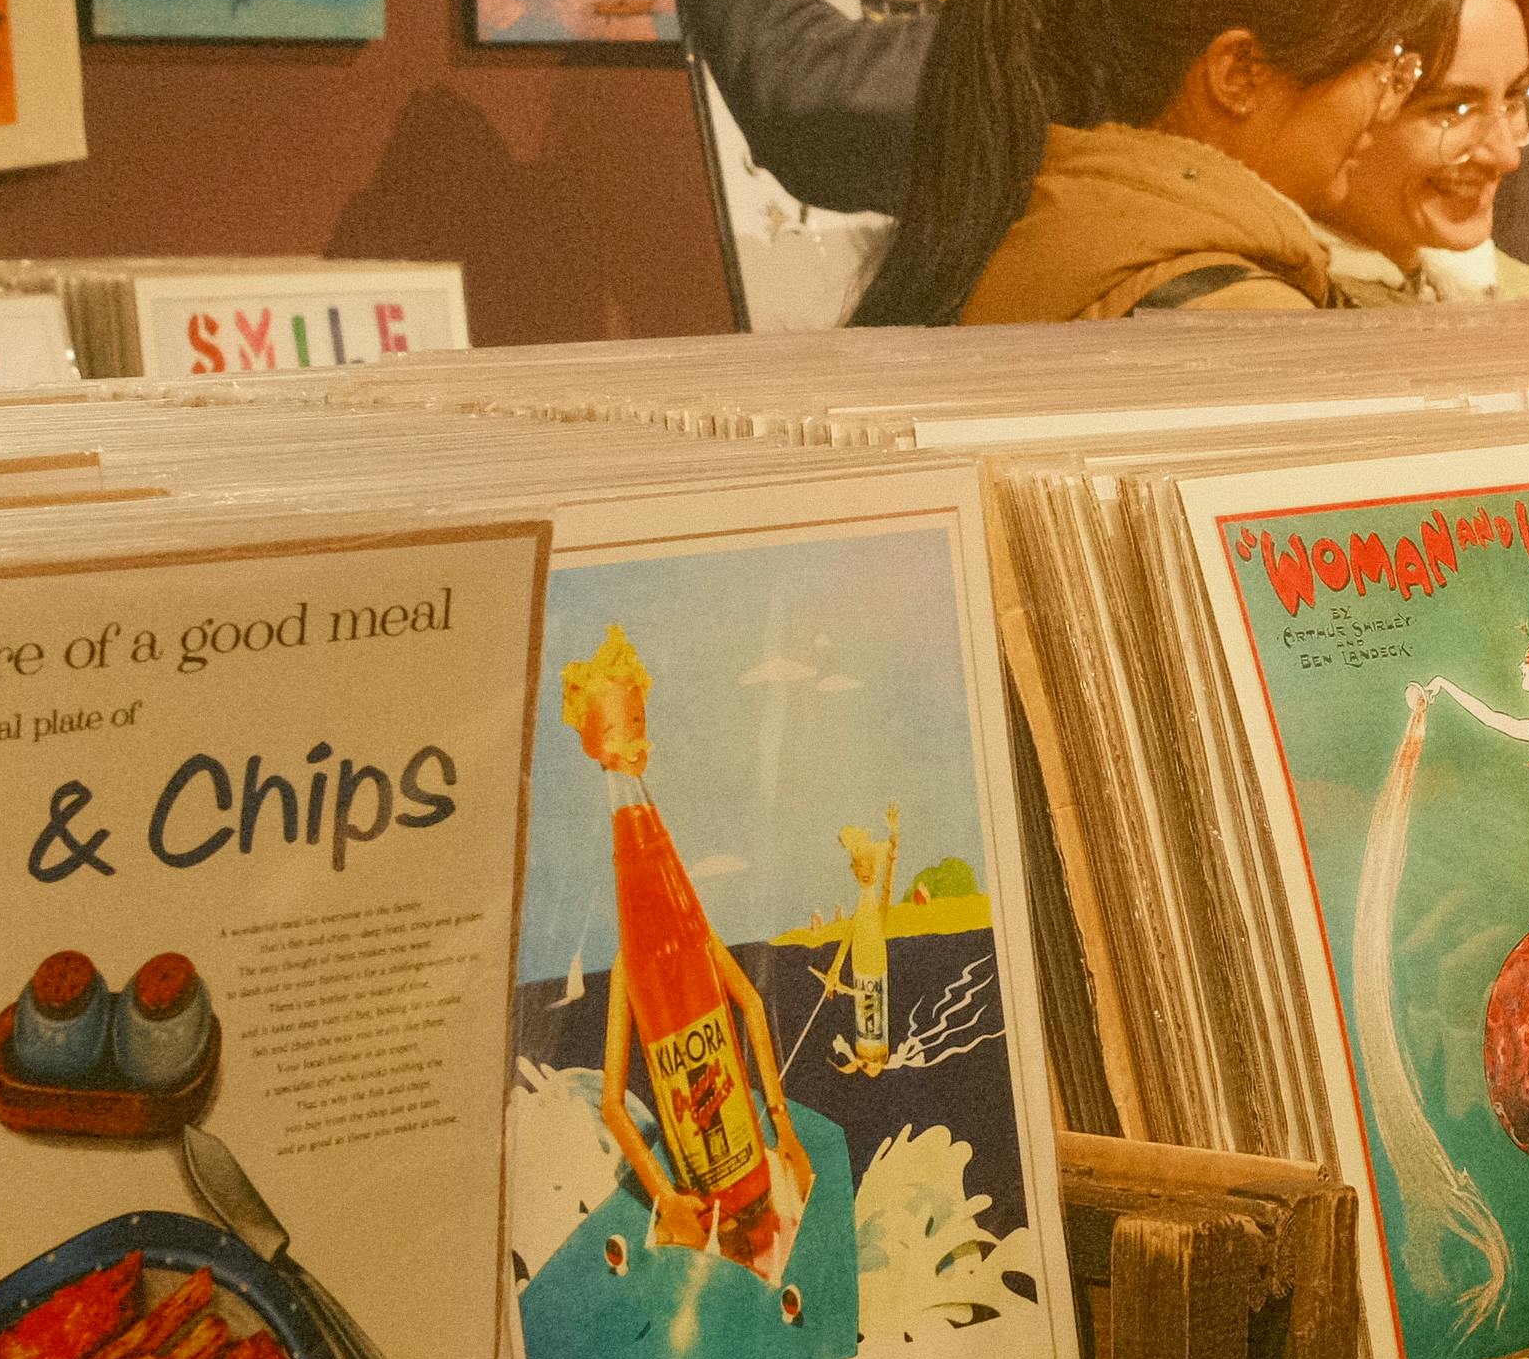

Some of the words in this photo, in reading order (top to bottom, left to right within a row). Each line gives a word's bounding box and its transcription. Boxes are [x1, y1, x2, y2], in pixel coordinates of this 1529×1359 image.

[187, 301, 409, 374] SMILE
[1455, 501, 1514, 555] AND
[65, 622, 124, 672] of
[131, 629, 164, 665] a
[177, 600, 309, 675] good
[327, 587, 454, 646] meal
[1329, 605, 1352, 620] BY
[1299, 653, 1334, 670] BEN
[31, 704, 104, 746] plate
[109, 700, 145, 731] of
[27, 778, 116, 886] &
[146, 739, 459, 873] Chips
[655, 1017, 727, 1079] KIA-ORA
